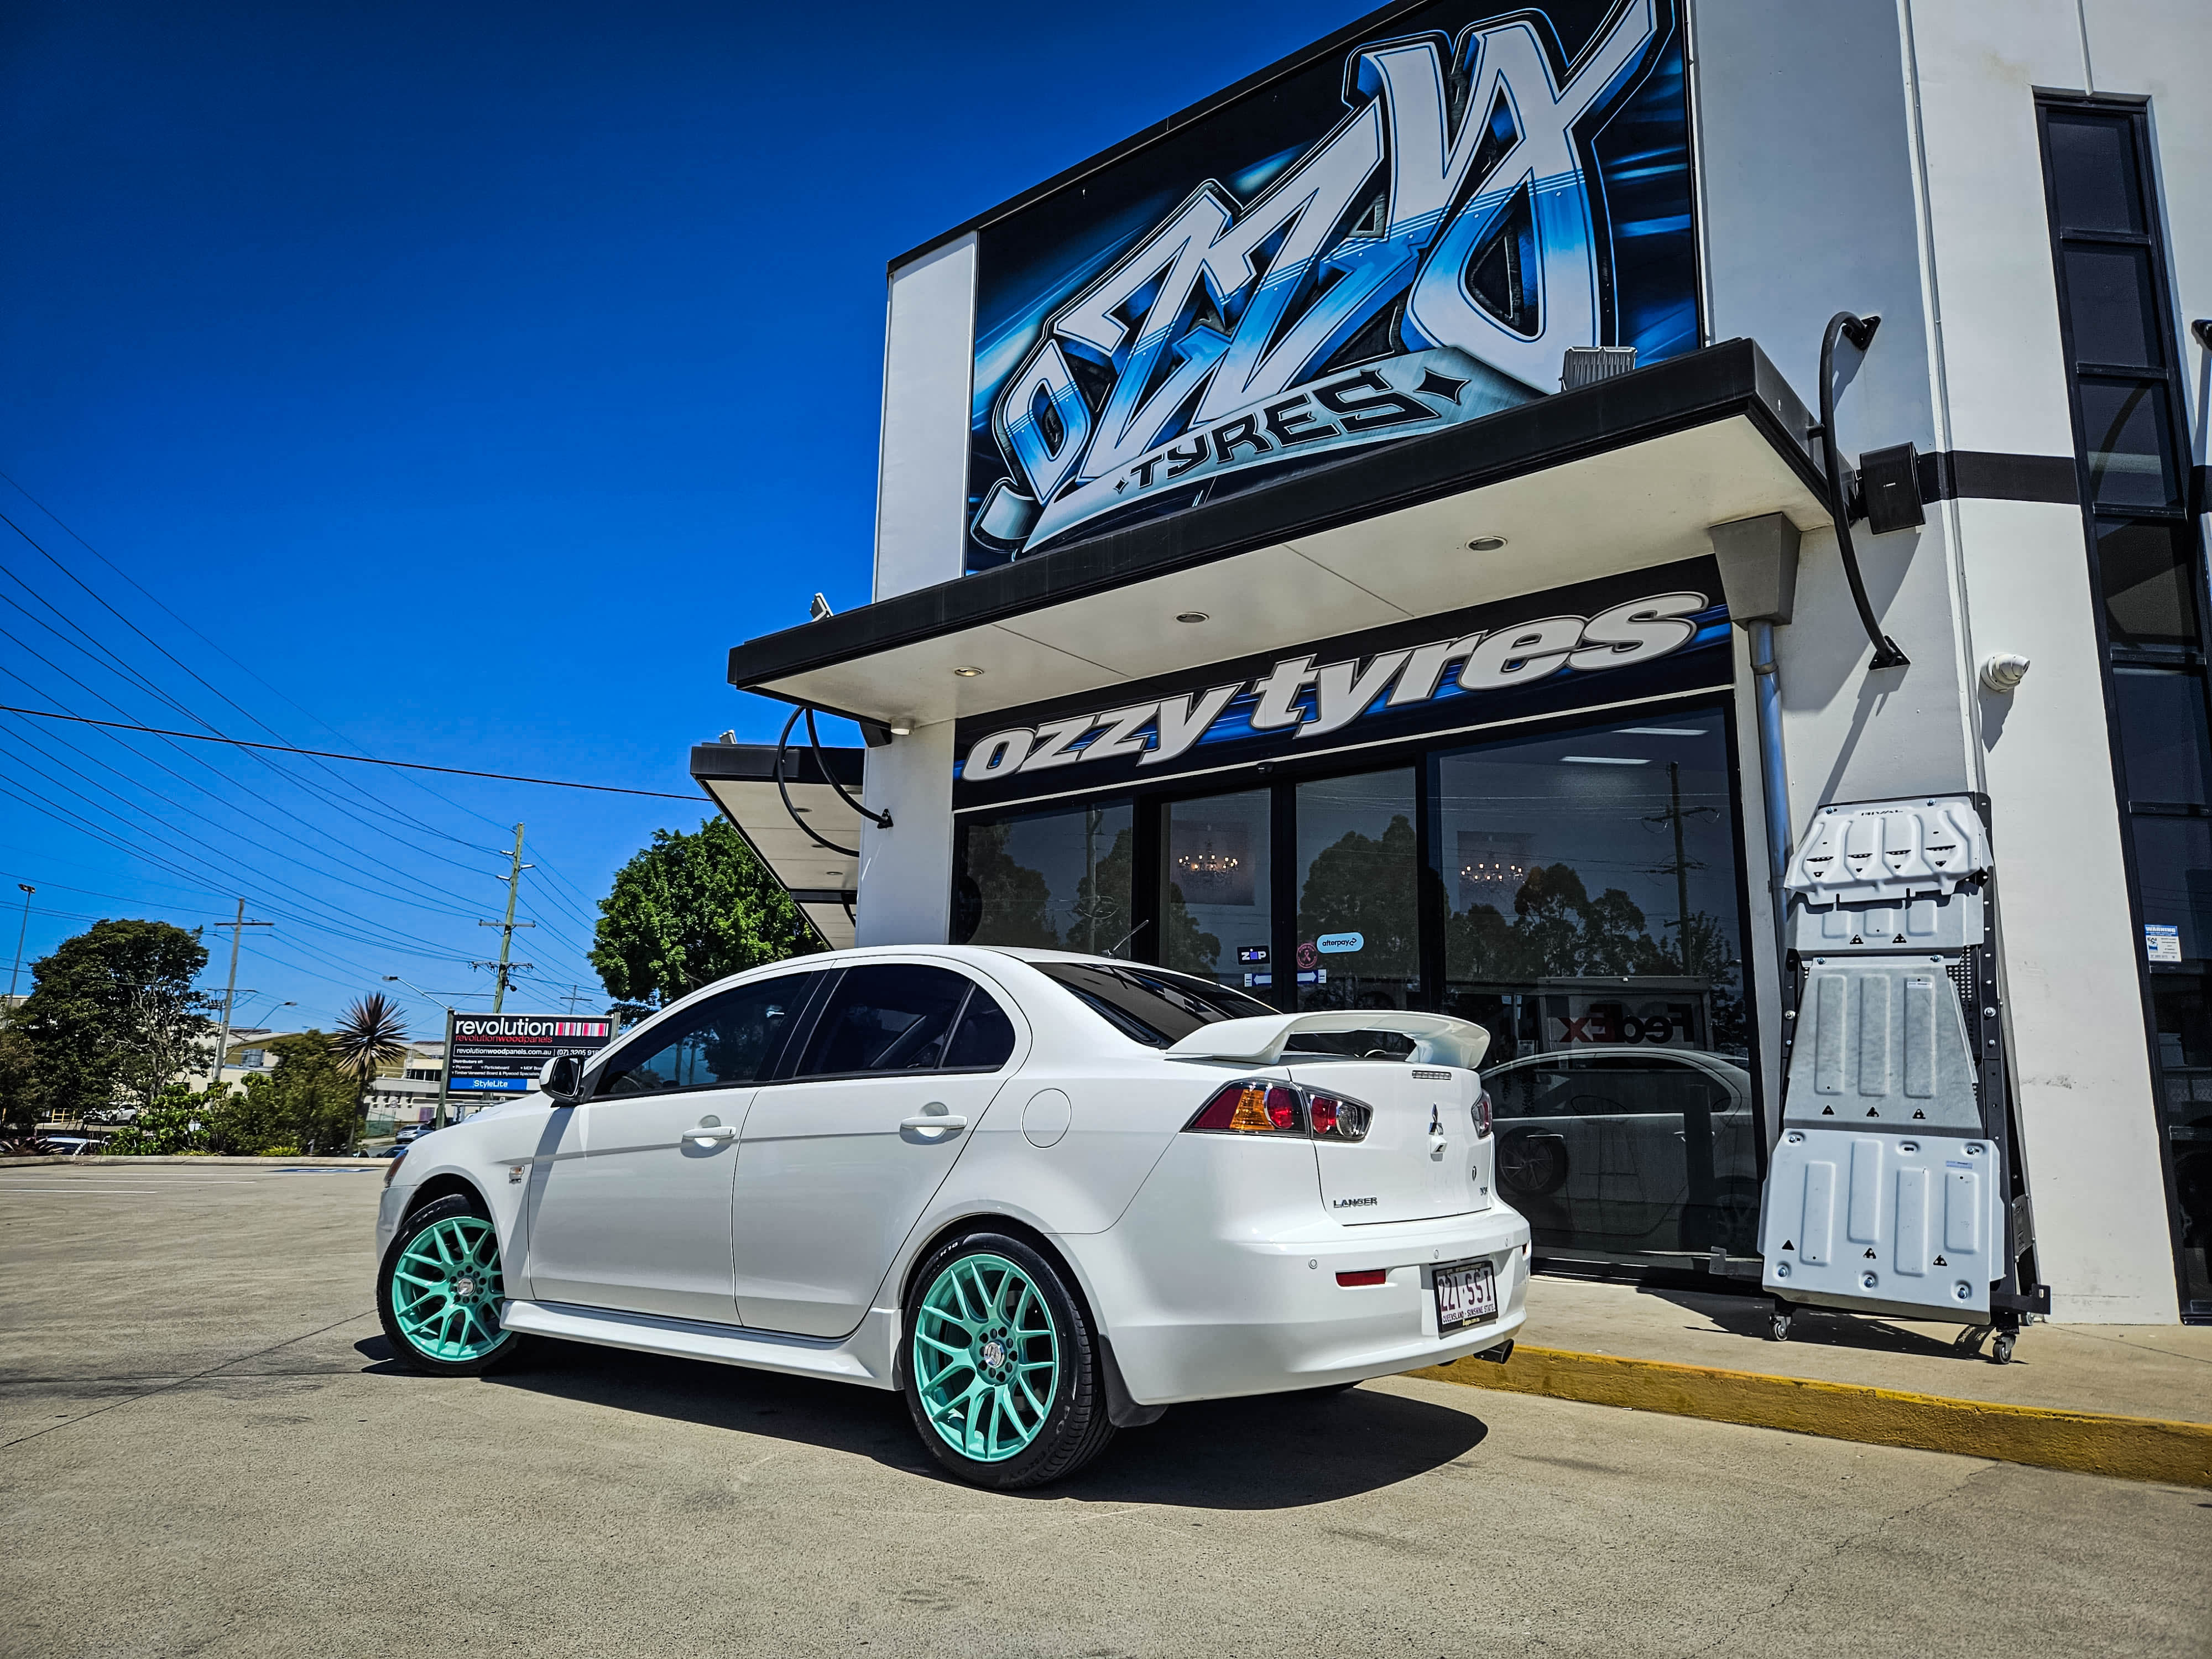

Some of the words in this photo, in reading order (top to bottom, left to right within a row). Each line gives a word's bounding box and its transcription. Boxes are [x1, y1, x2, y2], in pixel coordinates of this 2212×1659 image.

[1129, 368, 1442, 490] TYRES
[961, 681, 1245, 781] ozzy
[1250, 591, 1709, 739] tyres
[1322, 938, 1350, 947] afterpay
[455, 1017, 554, 1036] revolution
[455, 1034, 552, 1044] revolutionwoodpanels
[473, 1079, 508, 1088] StyleLite
[1442, 1311, 1464, 1323] QUEENSLAND
[1467, 1306, 1483, 1317] SUNSHINE
[1484, 1303, 1494, 1313] STATE
